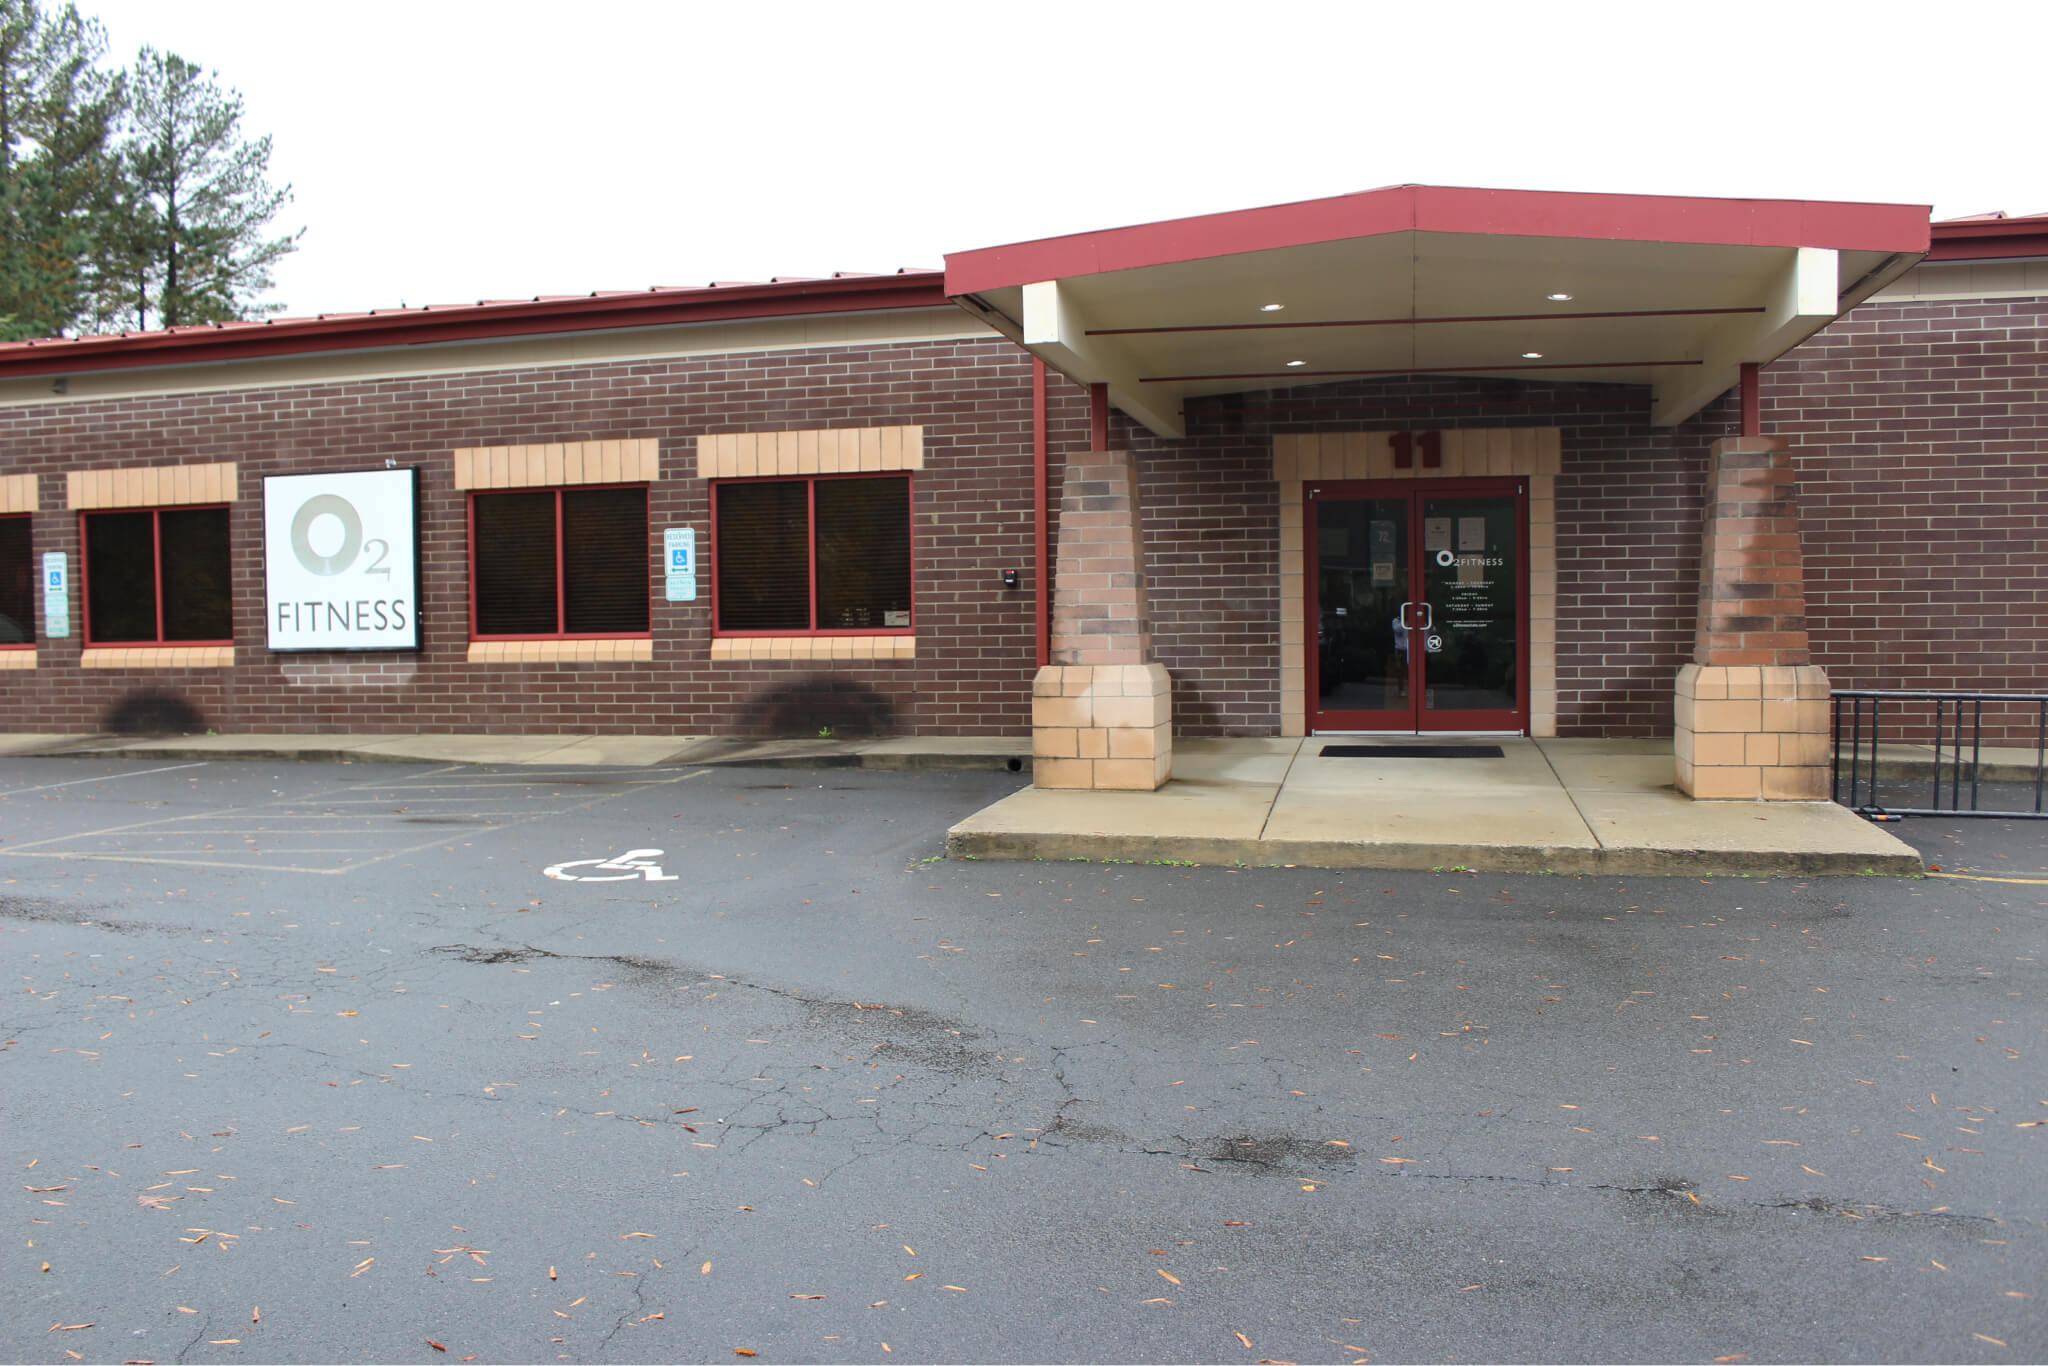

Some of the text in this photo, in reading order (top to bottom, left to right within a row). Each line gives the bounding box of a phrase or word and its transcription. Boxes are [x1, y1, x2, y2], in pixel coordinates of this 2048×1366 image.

[1388, 431, 1441, 468] 11
[290, 493, 391, 582] O2
[278, 600, 406, 632] FITNESS
